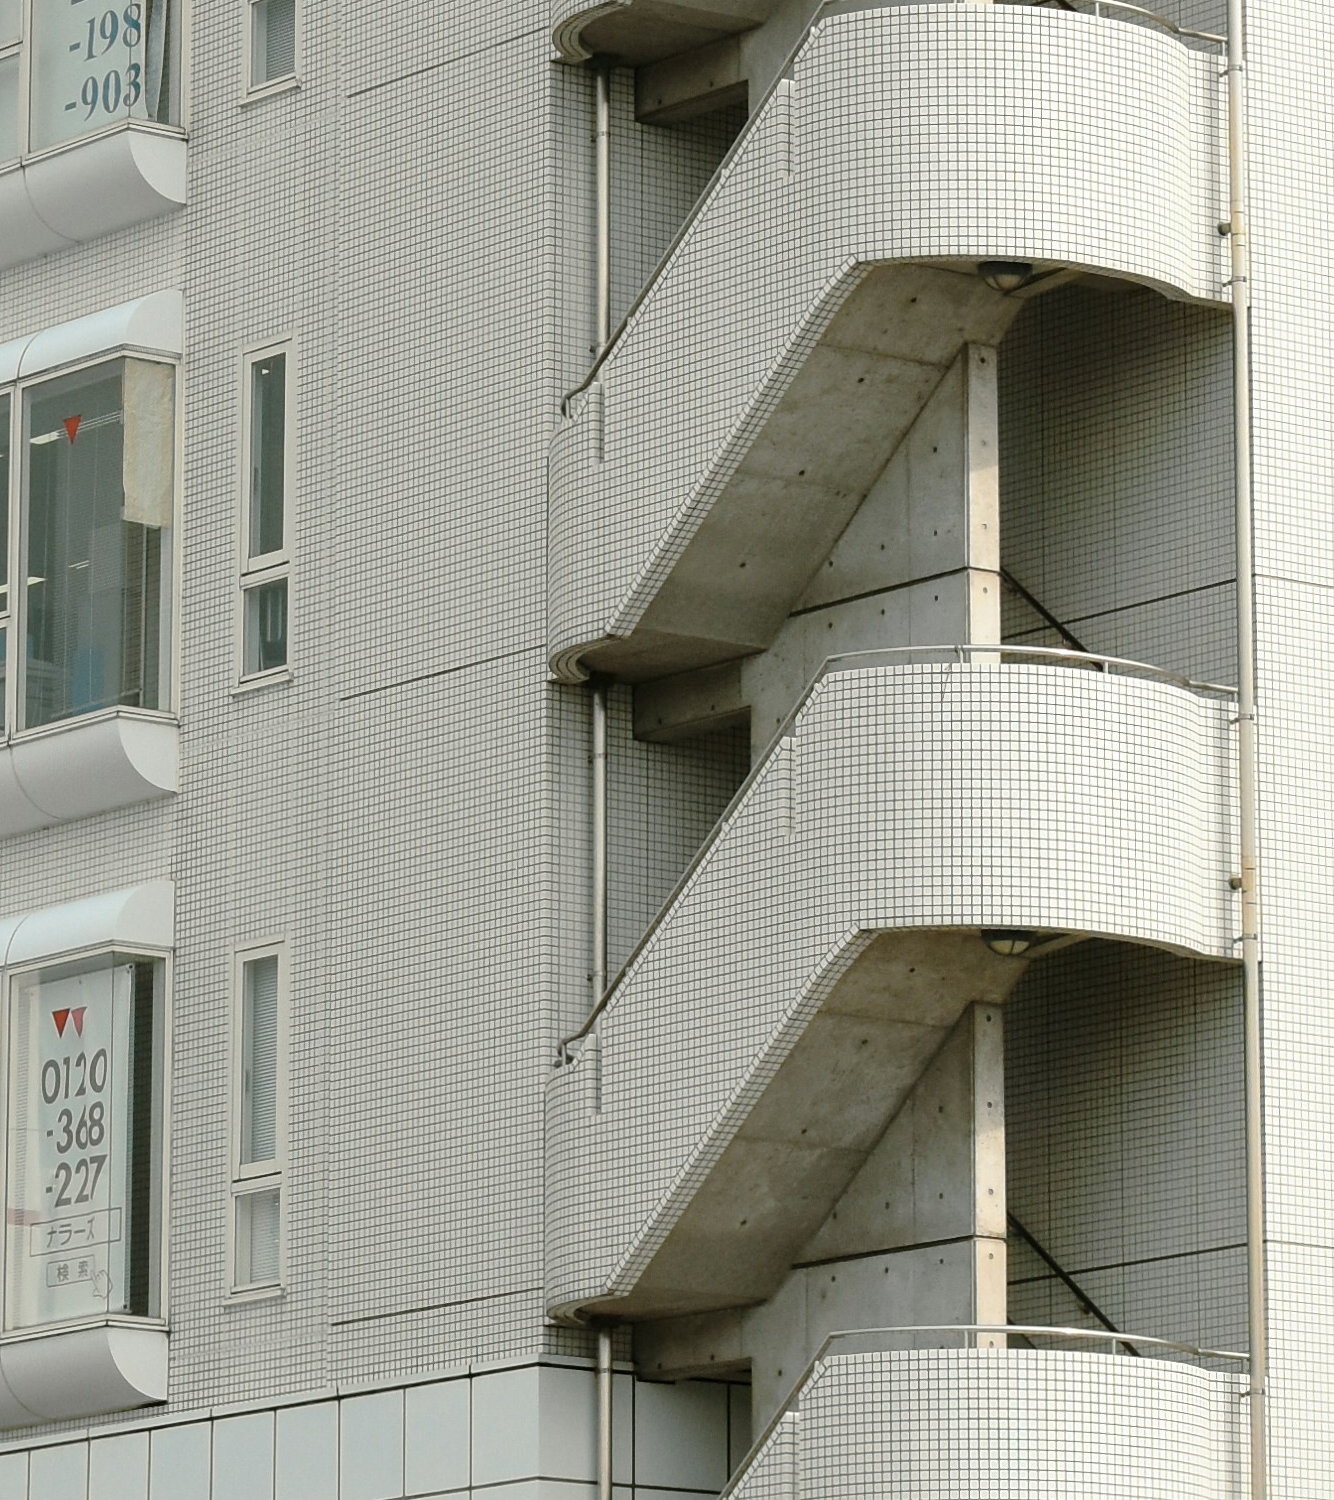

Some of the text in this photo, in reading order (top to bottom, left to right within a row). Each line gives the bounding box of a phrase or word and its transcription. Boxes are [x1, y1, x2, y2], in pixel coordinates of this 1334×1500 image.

[69, 3, 141, 63] -198
[64, 62, 141, 122] -903
[41, 1048, 108, 1104] 0120
[46, 1100, 105, 1154] -368
[46, 1154, 108, 1208] -227
[46, 1217, 96, 1249] ナラーズ
